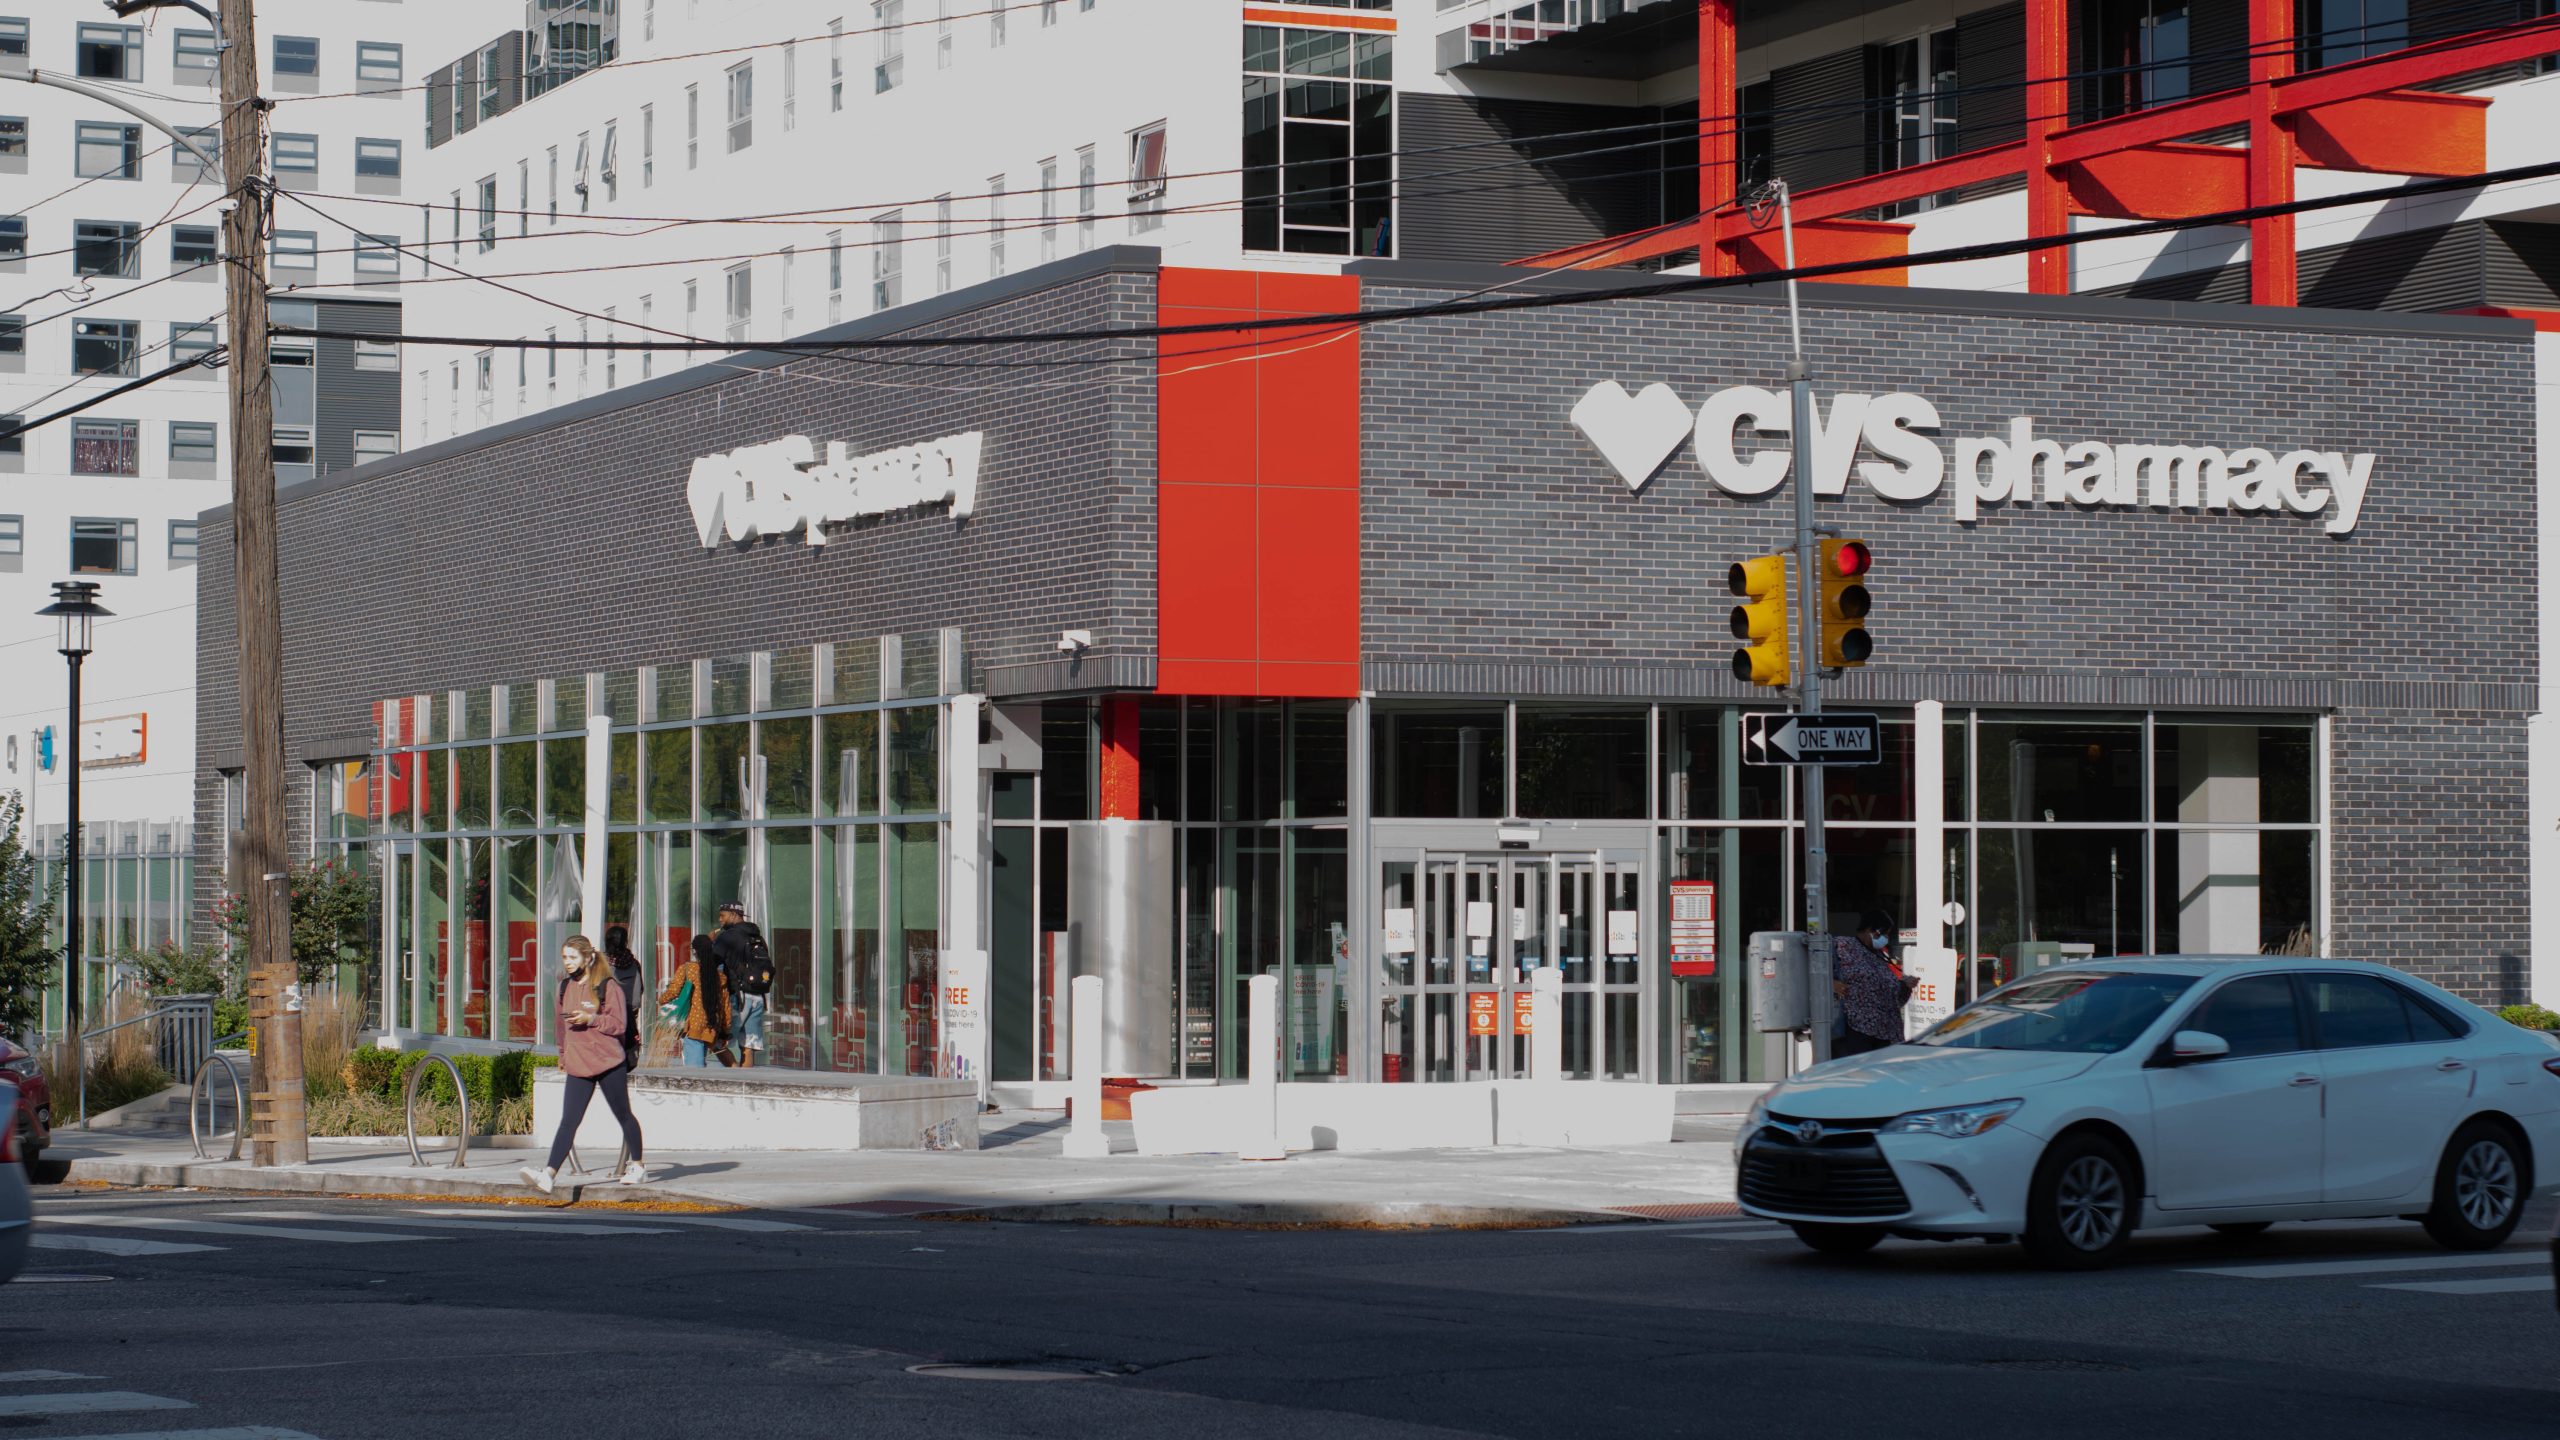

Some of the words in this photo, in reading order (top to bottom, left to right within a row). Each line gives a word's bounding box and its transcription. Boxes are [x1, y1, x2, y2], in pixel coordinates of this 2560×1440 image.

[1694, 384, 1944, 501] CVS
[1955, 416, 2377, 534] pharmacy
[1797, 729, 1829, 749] ONE
[1834, 729, 1866, 749] WAY
